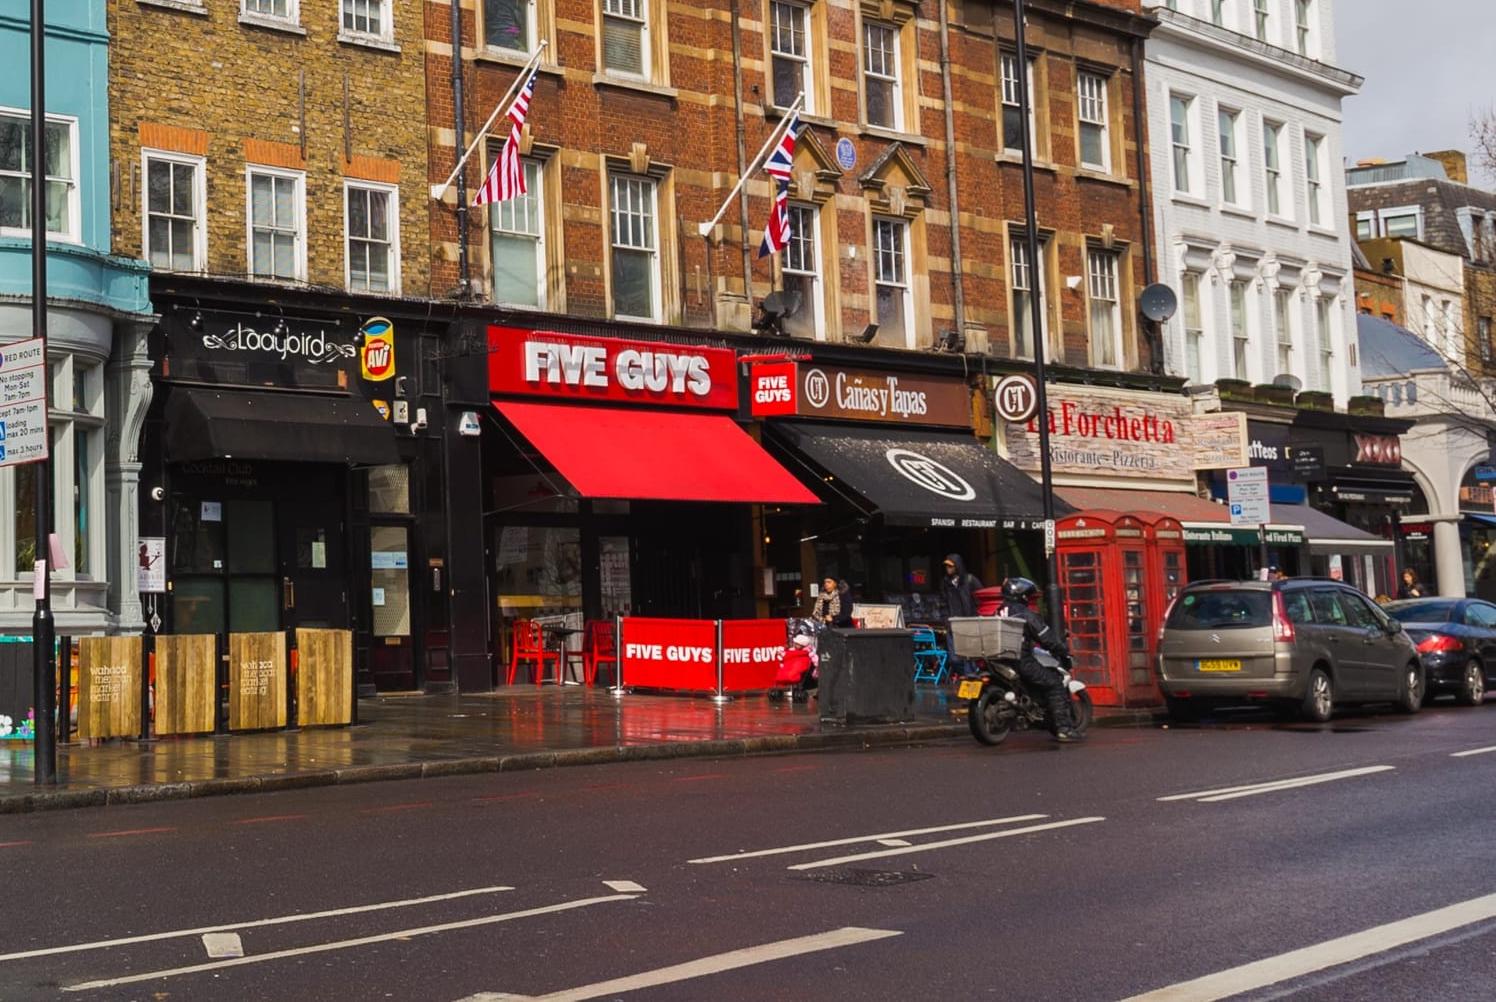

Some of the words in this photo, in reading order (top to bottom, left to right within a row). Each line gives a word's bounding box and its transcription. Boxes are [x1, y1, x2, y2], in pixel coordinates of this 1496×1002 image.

[4, 353, 18, 363] RED
[19, 348, 41, 359] ROUTE
[525, 341, 609, 387] FIVE
[616, 349, 711, 396] GUYS
[9, 371, 34, 383] stopping
[758, 376, 788, 389] FIVE
[755, 389, 791, 403] GUYS
[836, 372, 879, 412] Cañas
[880, 390, 888, 417] y
[887, 376, 927, 418] Tapas
[6, 420, 27, 430] loading
[1060, 401, 1175, 444] Forchetta
[6, 430, 18, 439] max
[20, 428, 29, 437] 20
[29, 426, 44, 435] mins
[7, 448, 19, 456] max
[25, 443, 43, 452] hours
[1248, 440, 1278, 459] atteos
[1113, 450, 1156, 469] Pizzeria
[931, 518, 955, 526] SPANISH
[961, 519, 997, 528] RESTAURANT
[1003, 520, 1015, 528] BAR
[626, 643, 662, 660] FIVE
[666, 646, 712, 663] GUYS
[723, 648, 750, 663] FIVE
[752, 646, 785, 662] GUYS
